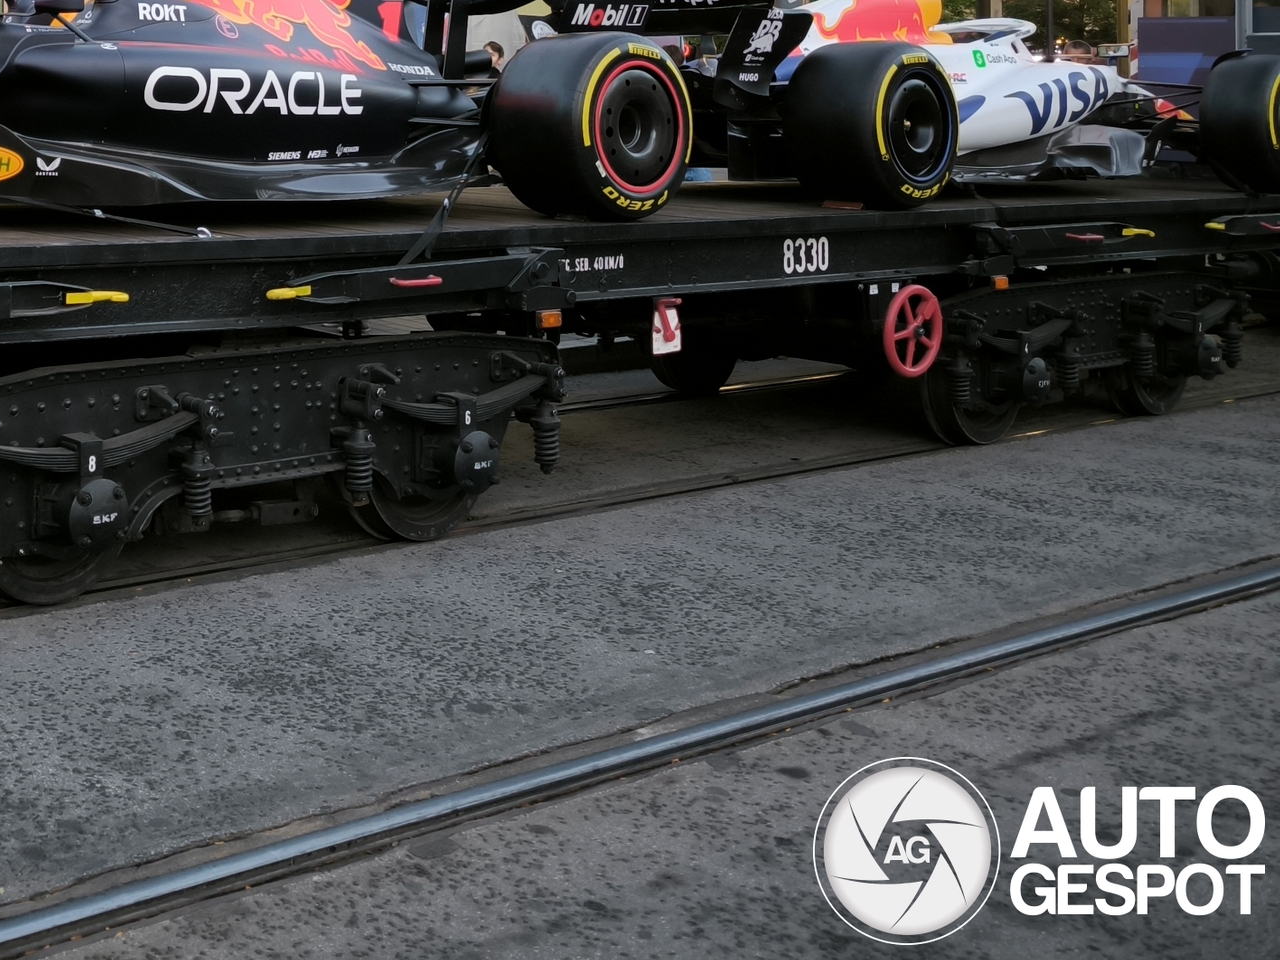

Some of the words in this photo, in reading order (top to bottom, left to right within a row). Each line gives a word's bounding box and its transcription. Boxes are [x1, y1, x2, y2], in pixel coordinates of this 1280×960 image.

[138, 2, 188, 22] ROKT
[571, 3, 629, 27] Mobil
[767, 9, 784, 19] VISA
[627, 42, 661, 60] PIRELLI
[901, 53, 929, 65] PIRELLI
[986, 53, 1003, 64] Cash
[1003, 54, 1017, 65] App
[387, 62, 435, 76] HONDA
[738, 72, 759, 82] HUGO
[144, 66, 364, 115] ORACLE
[1004, 66, 1110, 136] VISA
[267, 150, 301, 161] SIEMENS
[602, 185, 656, 211] ZERO
[901, 183, 939, 199] ZERO
[783, 236, 829, 274] 8330
[464, 410, 472, 426] 6
[88, 455, 97, 472] 8
[92, 511, 119, 526] SKF
